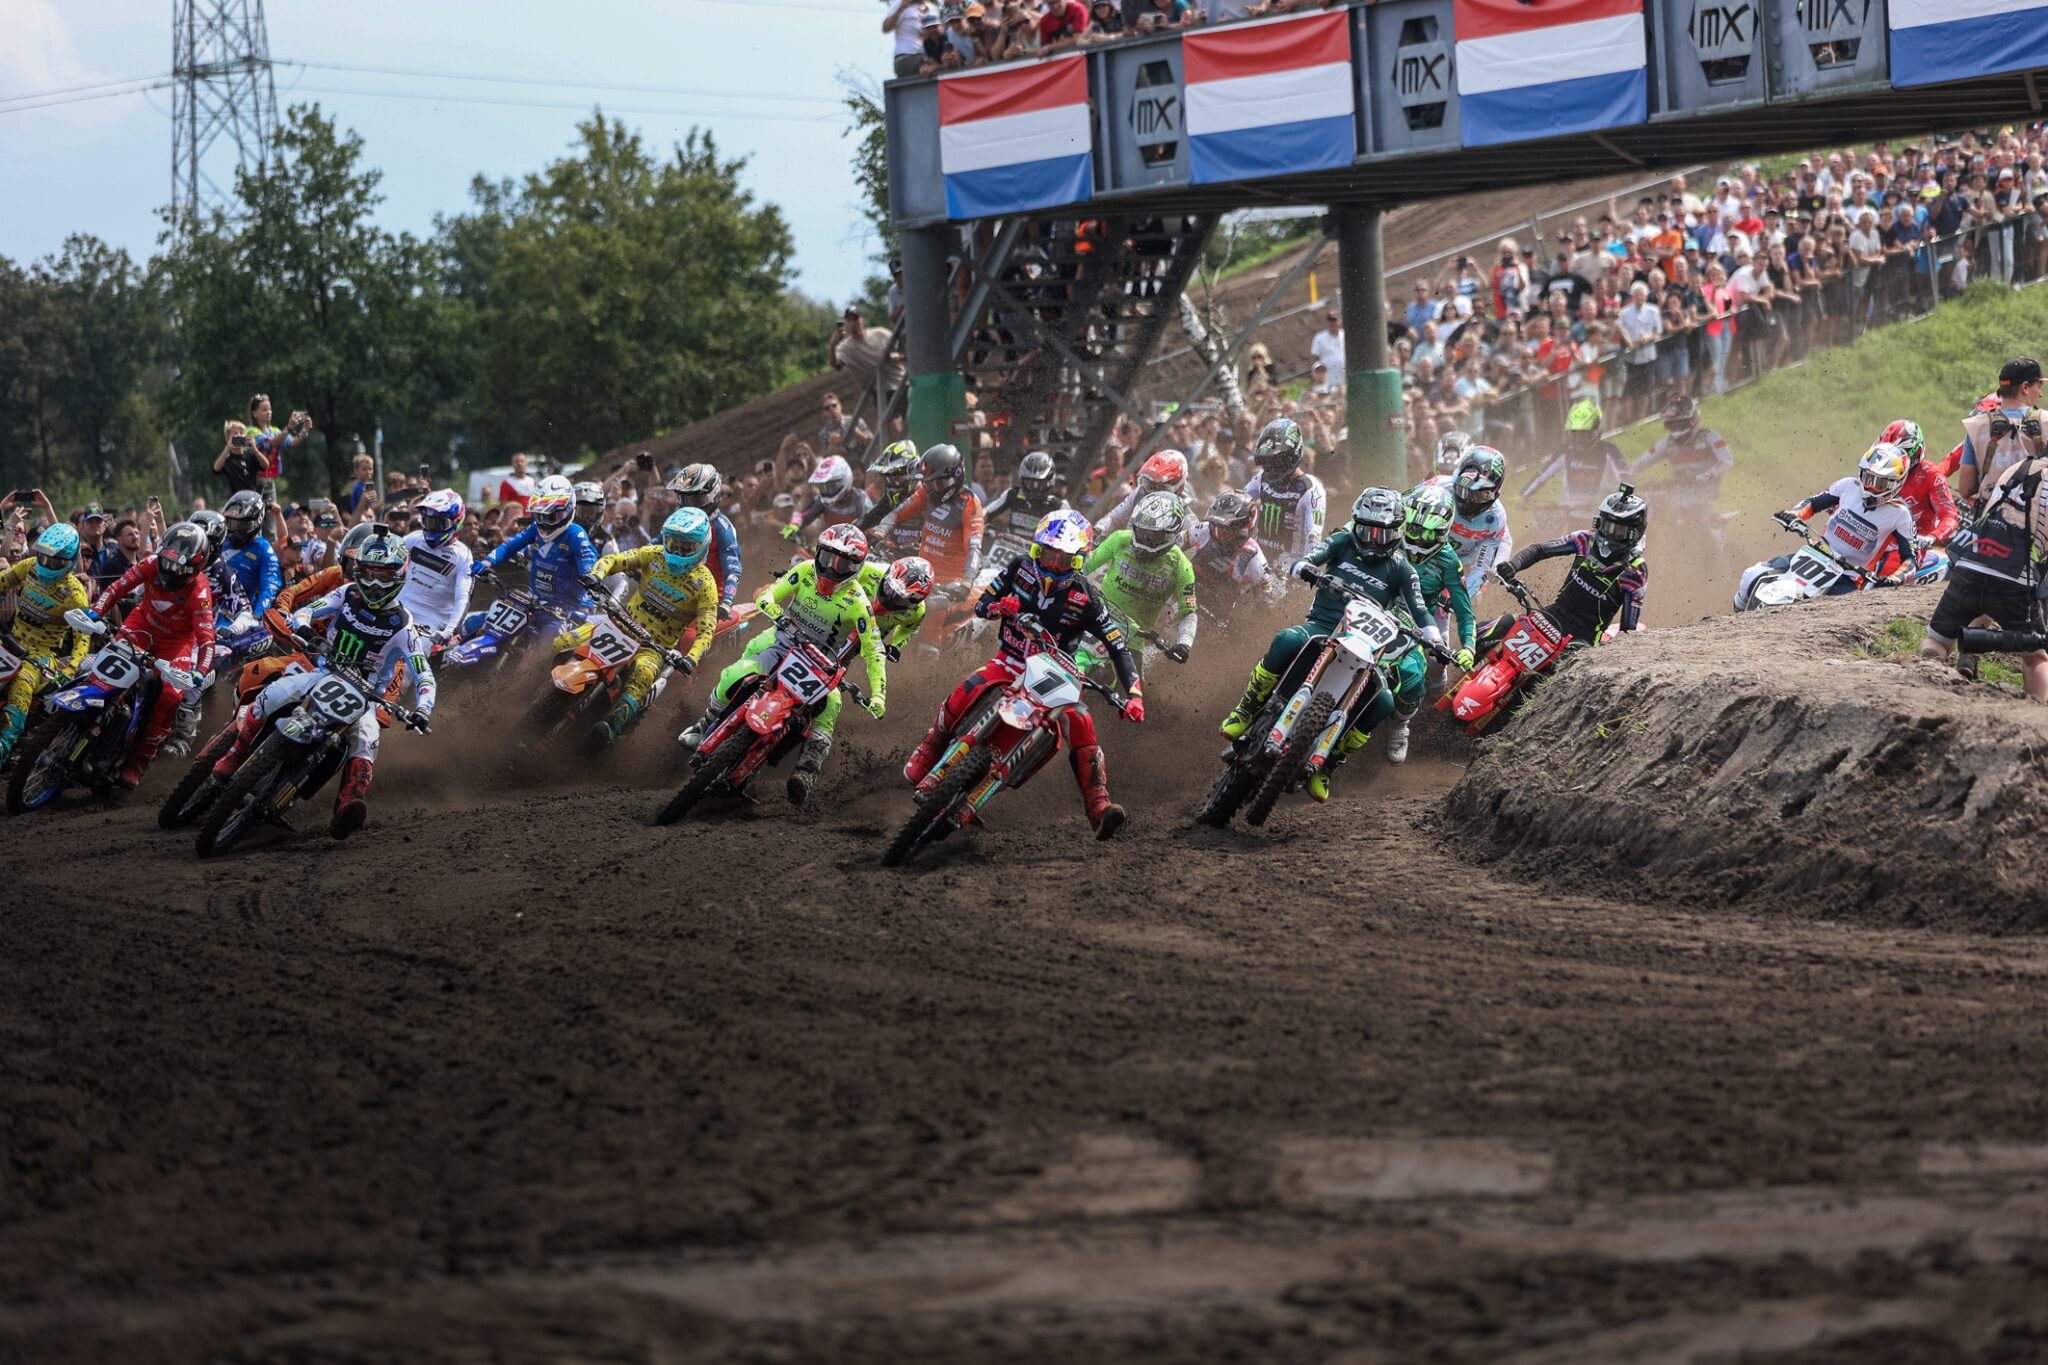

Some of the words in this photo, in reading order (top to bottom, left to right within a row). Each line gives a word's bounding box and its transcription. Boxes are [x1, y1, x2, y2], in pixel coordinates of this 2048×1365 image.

[1700, 4, 1750, 50] MX
[1402, 53, 1445, 95] MX
[1138, 96, 1177, 134] MX
[1571, 571, 1608, 600] HONDA
[1791, 556, 1838, 588] 101
[486, 602, 526, 633] 313
[1349, 612, 1393, 643] 259
[590, 633, 634, 663] 811
[1504, 630, 1549, 669] 243
[97, 655, 131, 681] 6
[780, 662, 821, 698] 24
[1030, 669, 1068, 698] 1
[313, 681, 363, 718] 93
